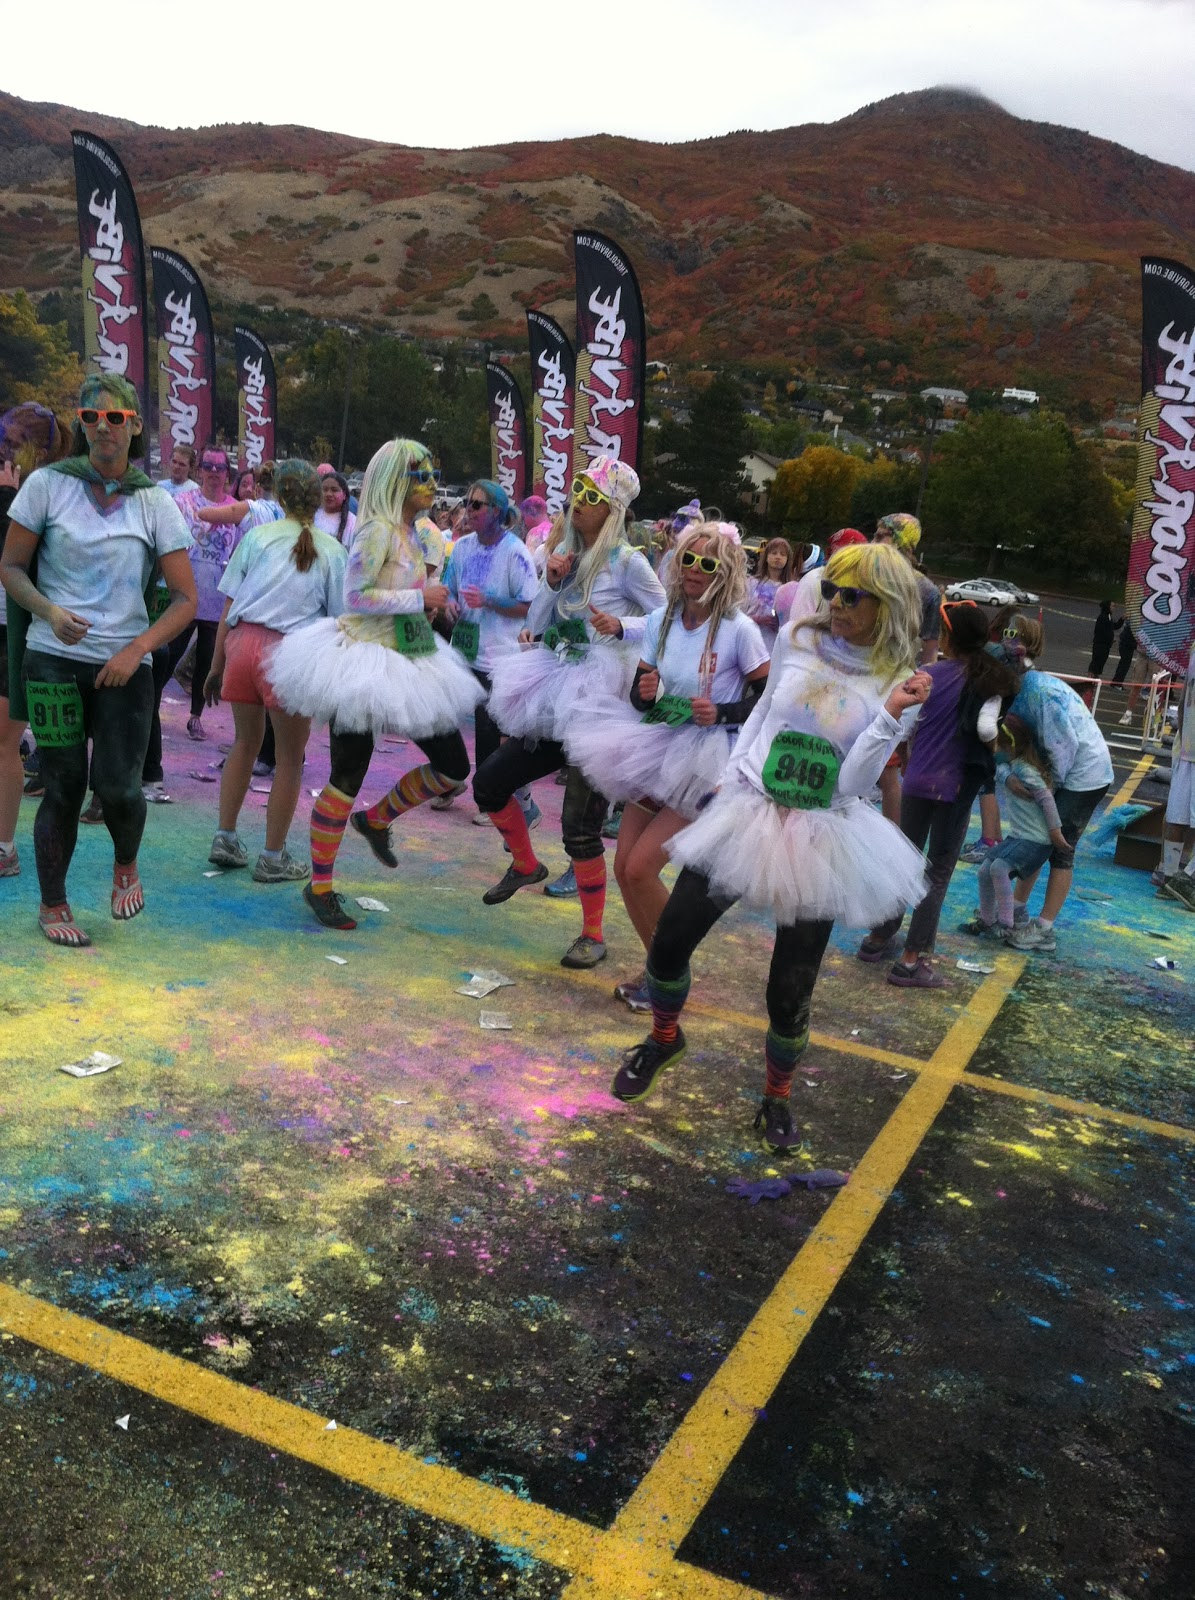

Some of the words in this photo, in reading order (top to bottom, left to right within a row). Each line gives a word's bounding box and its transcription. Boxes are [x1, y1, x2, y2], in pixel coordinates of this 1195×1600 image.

[202, 549, 221, 561] 1992
[33, 702, 77, 728] 915
[775, 754, 828, 790] 946
